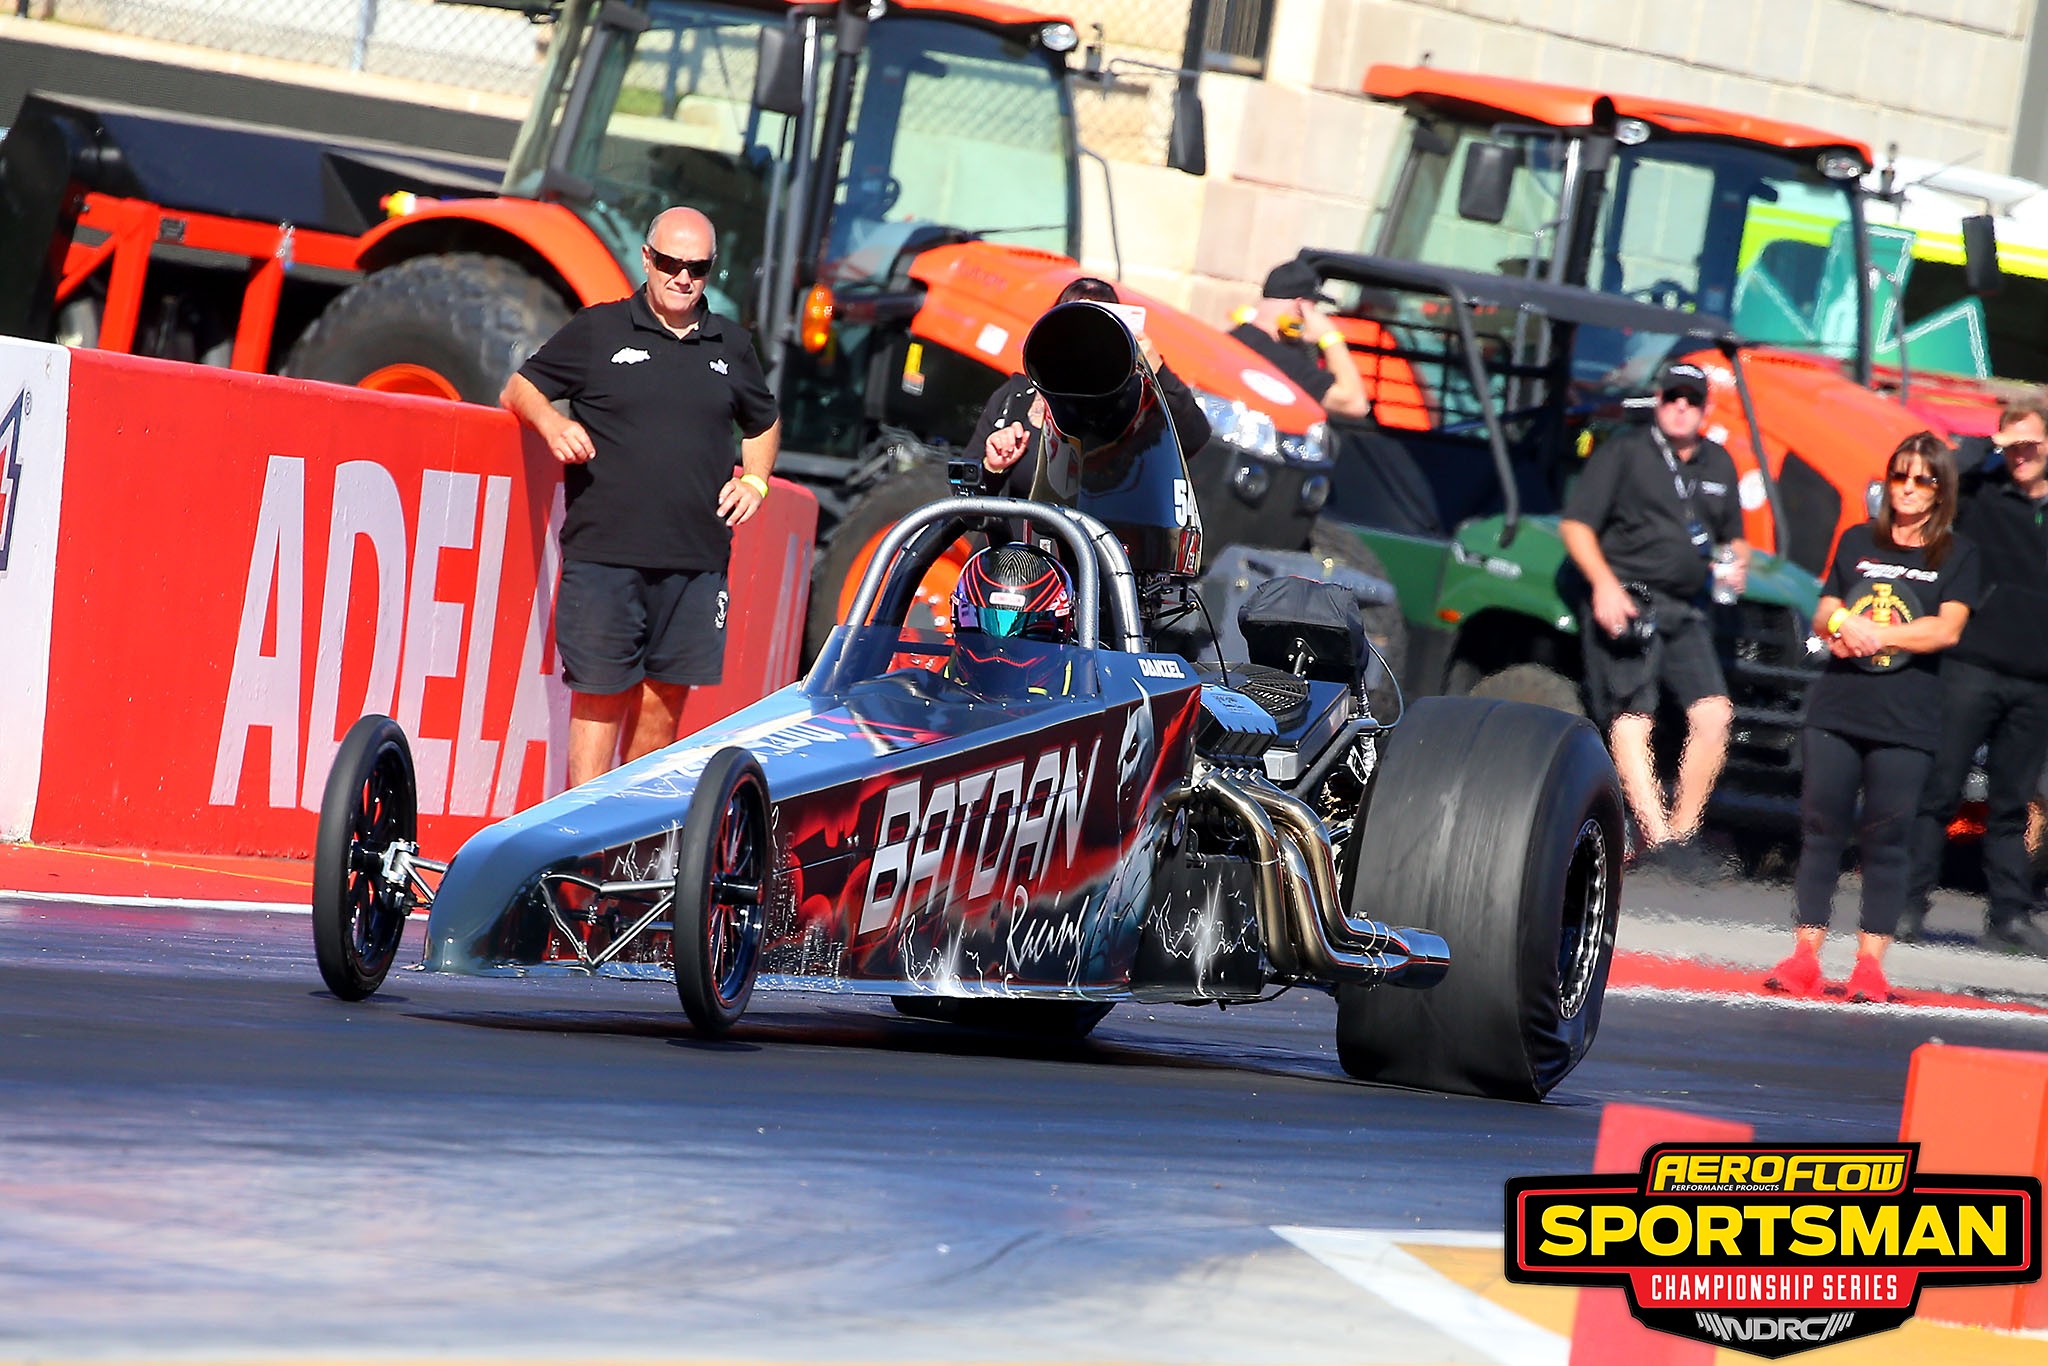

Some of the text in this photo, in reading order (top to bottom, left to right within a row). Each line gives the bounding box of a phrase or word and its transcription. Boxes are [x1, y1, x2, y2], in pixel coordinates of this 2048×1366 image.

[1137, 658, 1186, 679] DANIEL
[858, 736, 1102, 935] BATDAN
[1003, 884, 1090, 987] Racing
